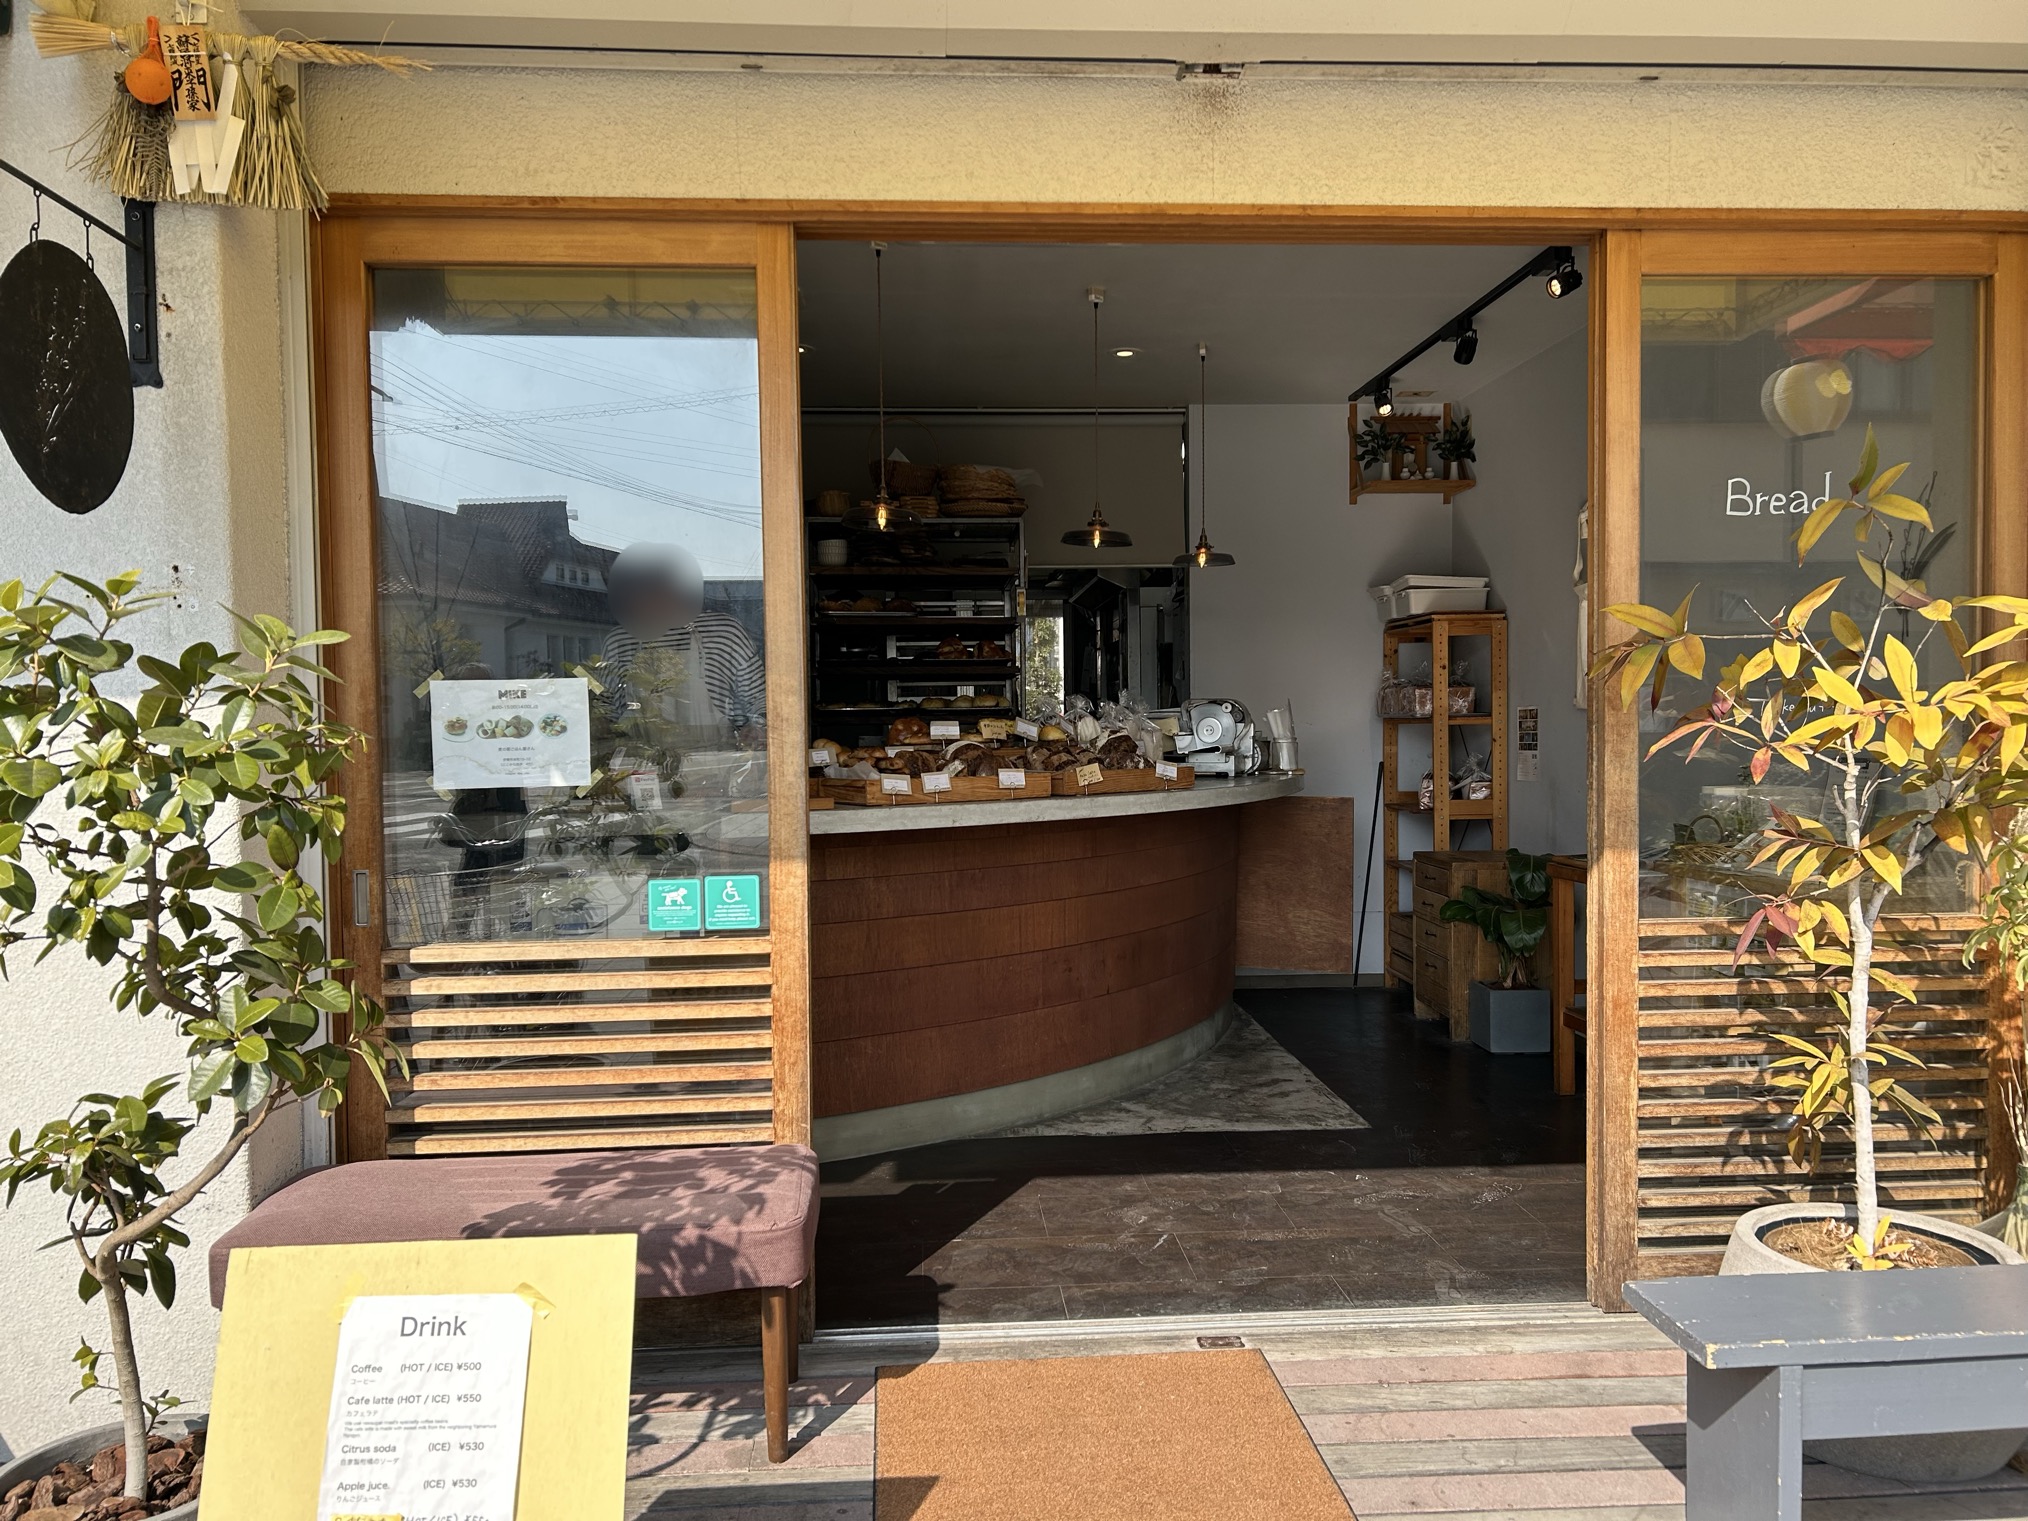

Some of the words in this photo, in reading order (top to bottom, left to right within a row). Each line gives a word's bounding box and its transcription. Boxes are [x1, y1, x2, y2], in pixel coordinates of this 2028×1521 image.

[1725, 471, 1832, 517] Bread
[498, 690, 526, 699] MIKE
[1747, 697, 1795, 715] Tke
[400, 1315, 467, 1337] Drink
[351, 1364, 383, 1374] Coffee
[400, 1363, 425, 1373] (HOT
[434, 1362, 453, 1373] ICE)
[456, 1362, 482, 1371] ¥500
[347, 1396, 370, 1405] Cafe
[372, 1395, 394, 1405] latte
[397, 1395, 422, 1405] (HOT
[431, 1394, 450, 1404] ICE)
[457, 1393, 482, 1403] ¥550
[341, 1444, 371, 1454] Citrus
[373, 1444, 397, 1453] soda
[428, 1442, 451, 1452] (ICE)
[458, 1442, 484, 1451] ¥530
[337, 1481, 366, 1492] Apple
[423, 1480, 445, 1489] (ICE)
[452, 1479, 477, 1488] ¥530
